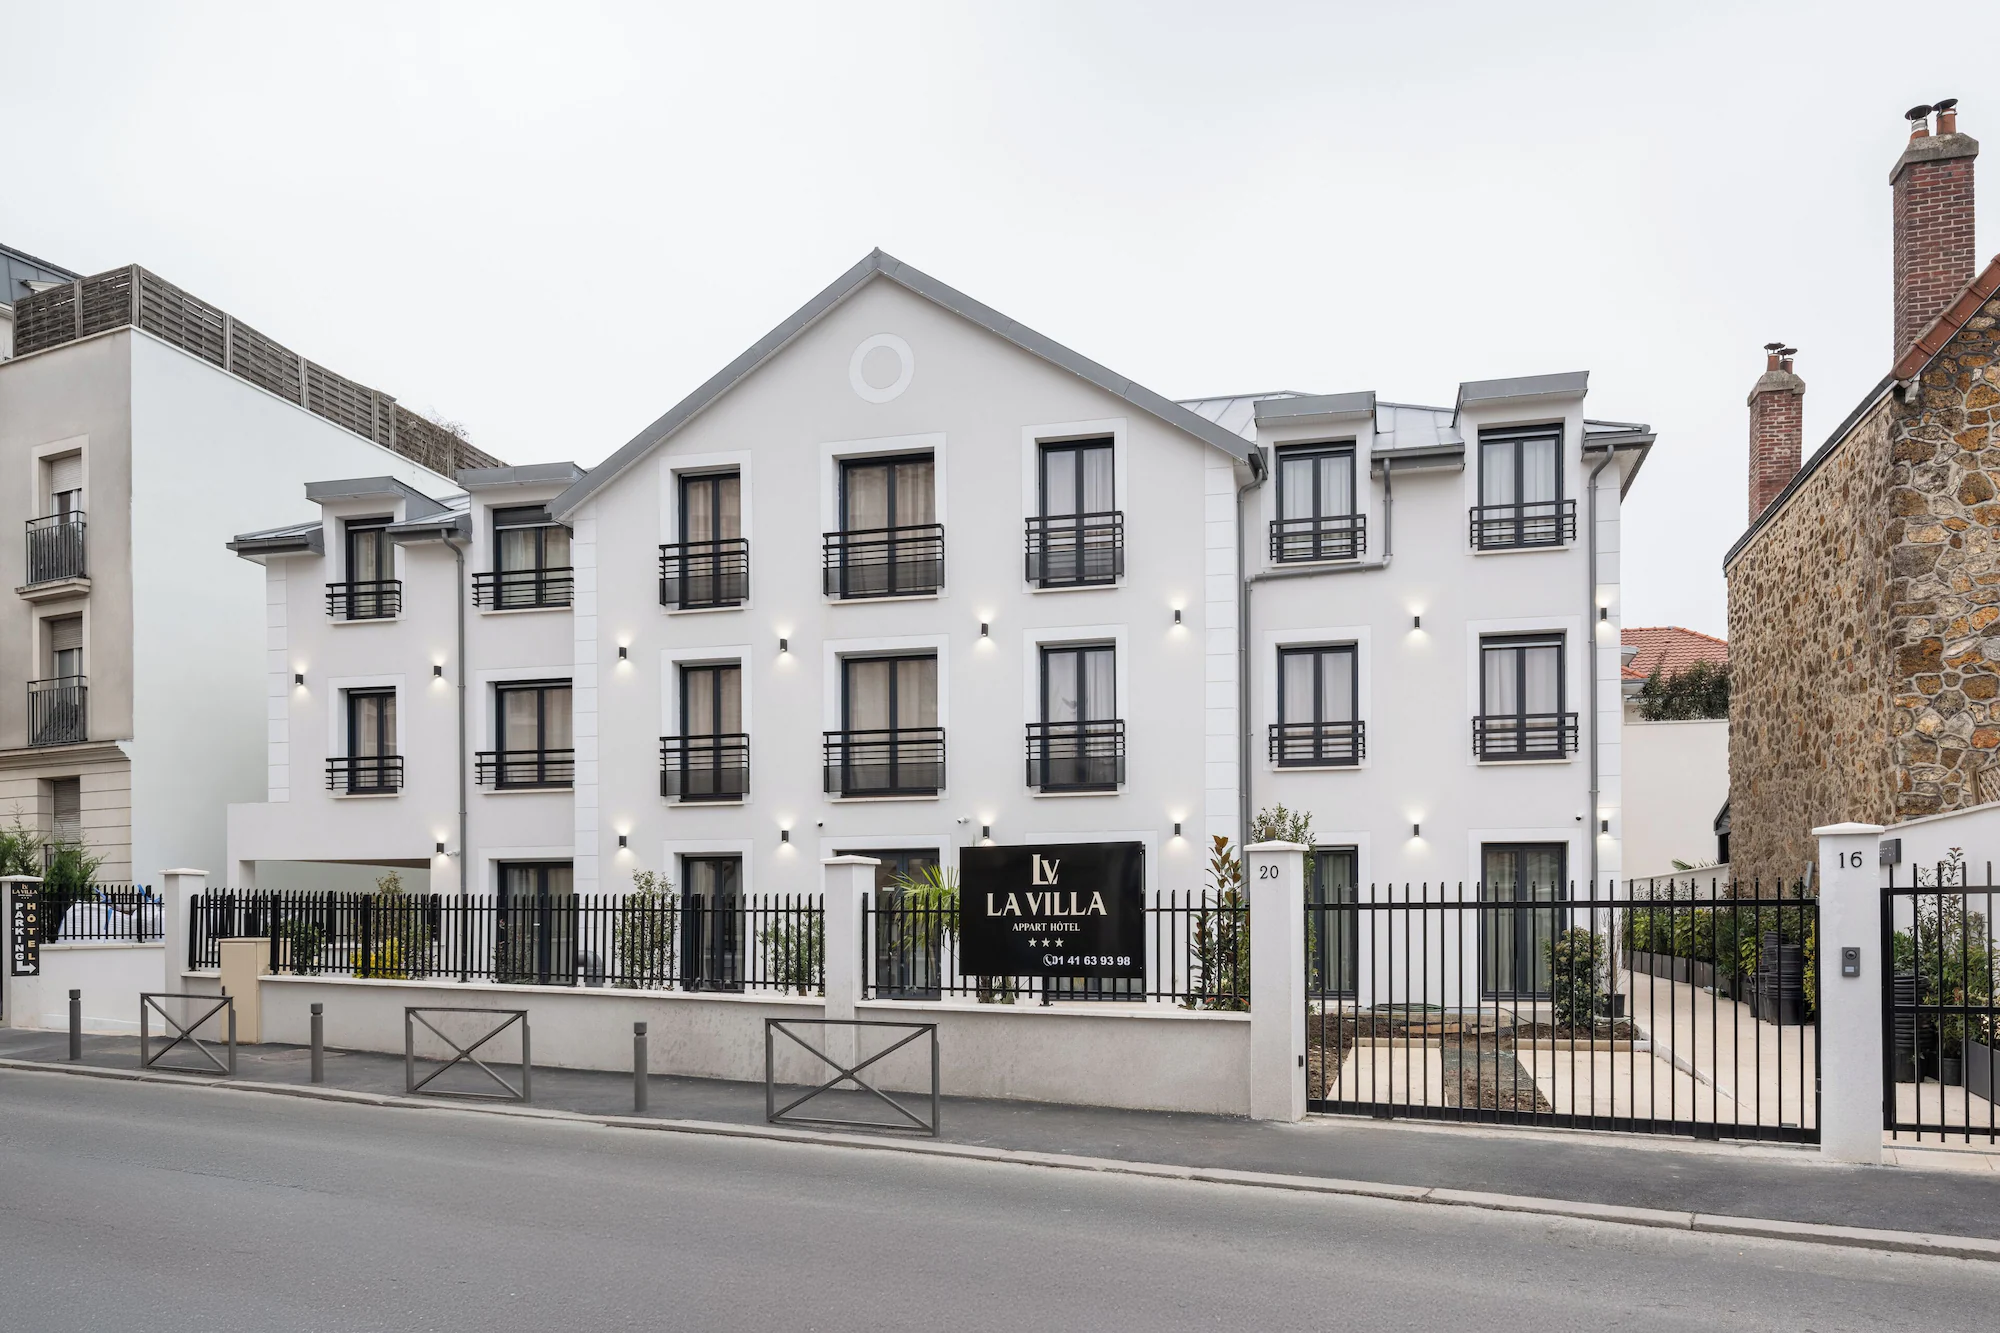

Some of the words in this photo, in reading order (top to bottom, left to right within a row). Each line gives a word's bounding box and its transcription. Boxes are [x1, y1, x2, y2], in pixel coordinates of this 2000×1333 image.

[1838, 851, 1862, 868] 16
[1259, 865, 1279, 879] 20
[987, 892, 1022, 916] LA
[1025, 891, 1107, 916] VILLA
[15, 902, 24, 960] PARKING
[27, 902, 36, 960] HÔTEL
[1012, 922, 1047, 931] APPART
[1050, 920, 1080, 931] HÔTEL
[1052, 955, 1064, 965] 01
[1067, 955, 1080, 965] 41
[1083, 955, 1097, 965] 63
[1100, 955, 1114, 965] 93
[1116, 956, 1131, 965] 98
